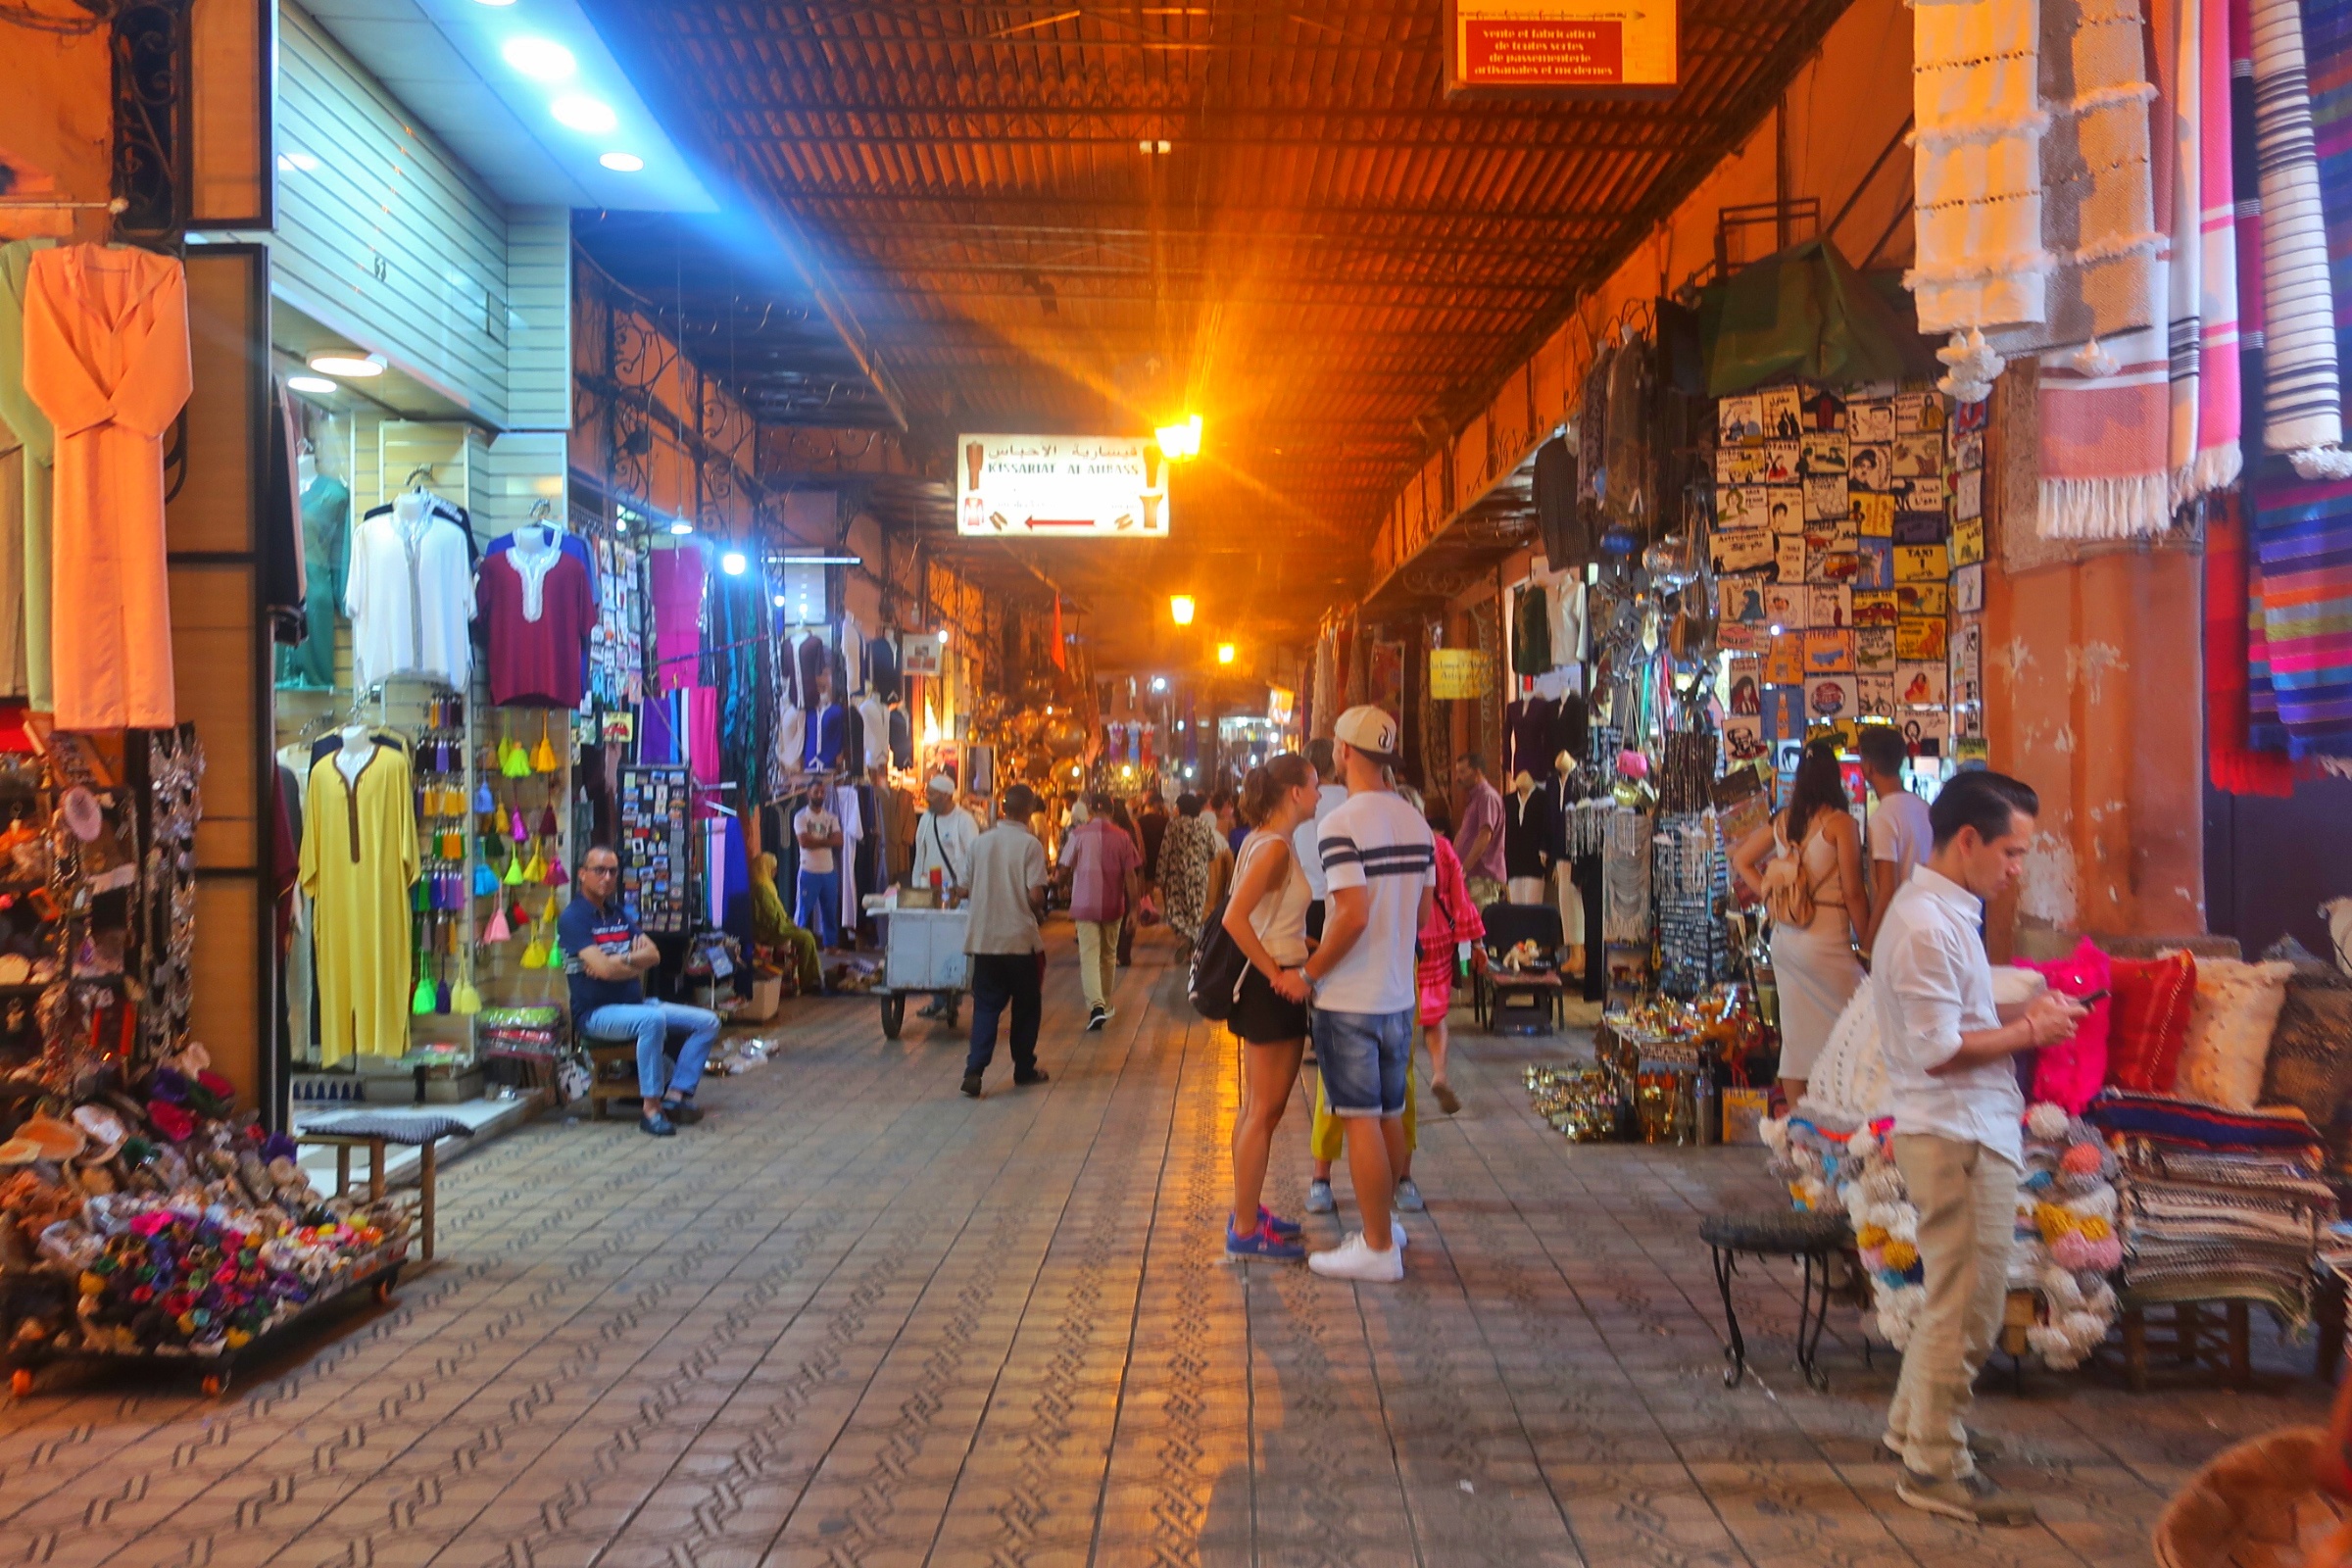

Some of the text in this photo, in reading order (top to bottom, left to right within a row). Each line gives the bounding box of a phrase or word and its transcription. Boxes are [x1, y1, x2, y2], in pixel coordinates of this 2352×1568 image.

[1483, 28, 1596, 39] vente et fabrication
[1494, 40, 1585, 51] de toutes sortes
[1489, 53, 1592, 65] de passementerie
[1474, 65, 1613, 75] artisanales et modernes
